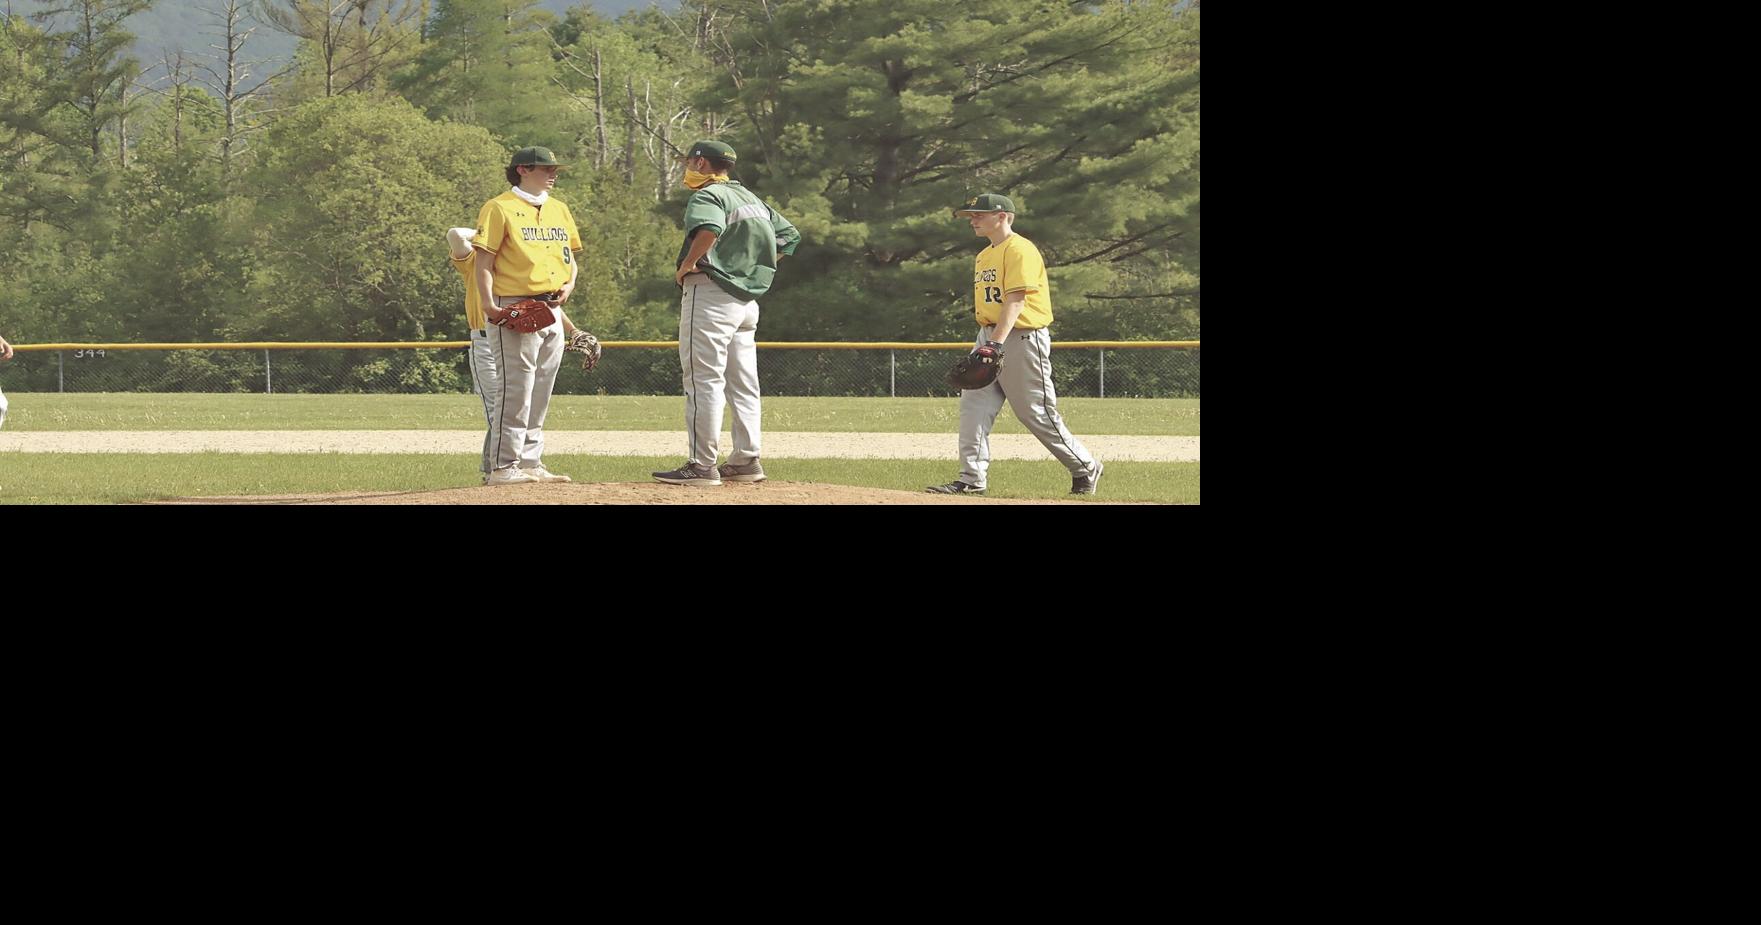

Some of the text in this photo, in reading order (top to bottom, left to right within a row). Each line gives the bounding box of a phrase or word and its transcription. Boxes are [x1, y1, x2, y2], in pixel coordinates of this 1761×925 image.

[521, 227, 569, 242] BULLDOGS
[562, 246, 571, 265] 9
[984, 286, 1003, 304] 12
